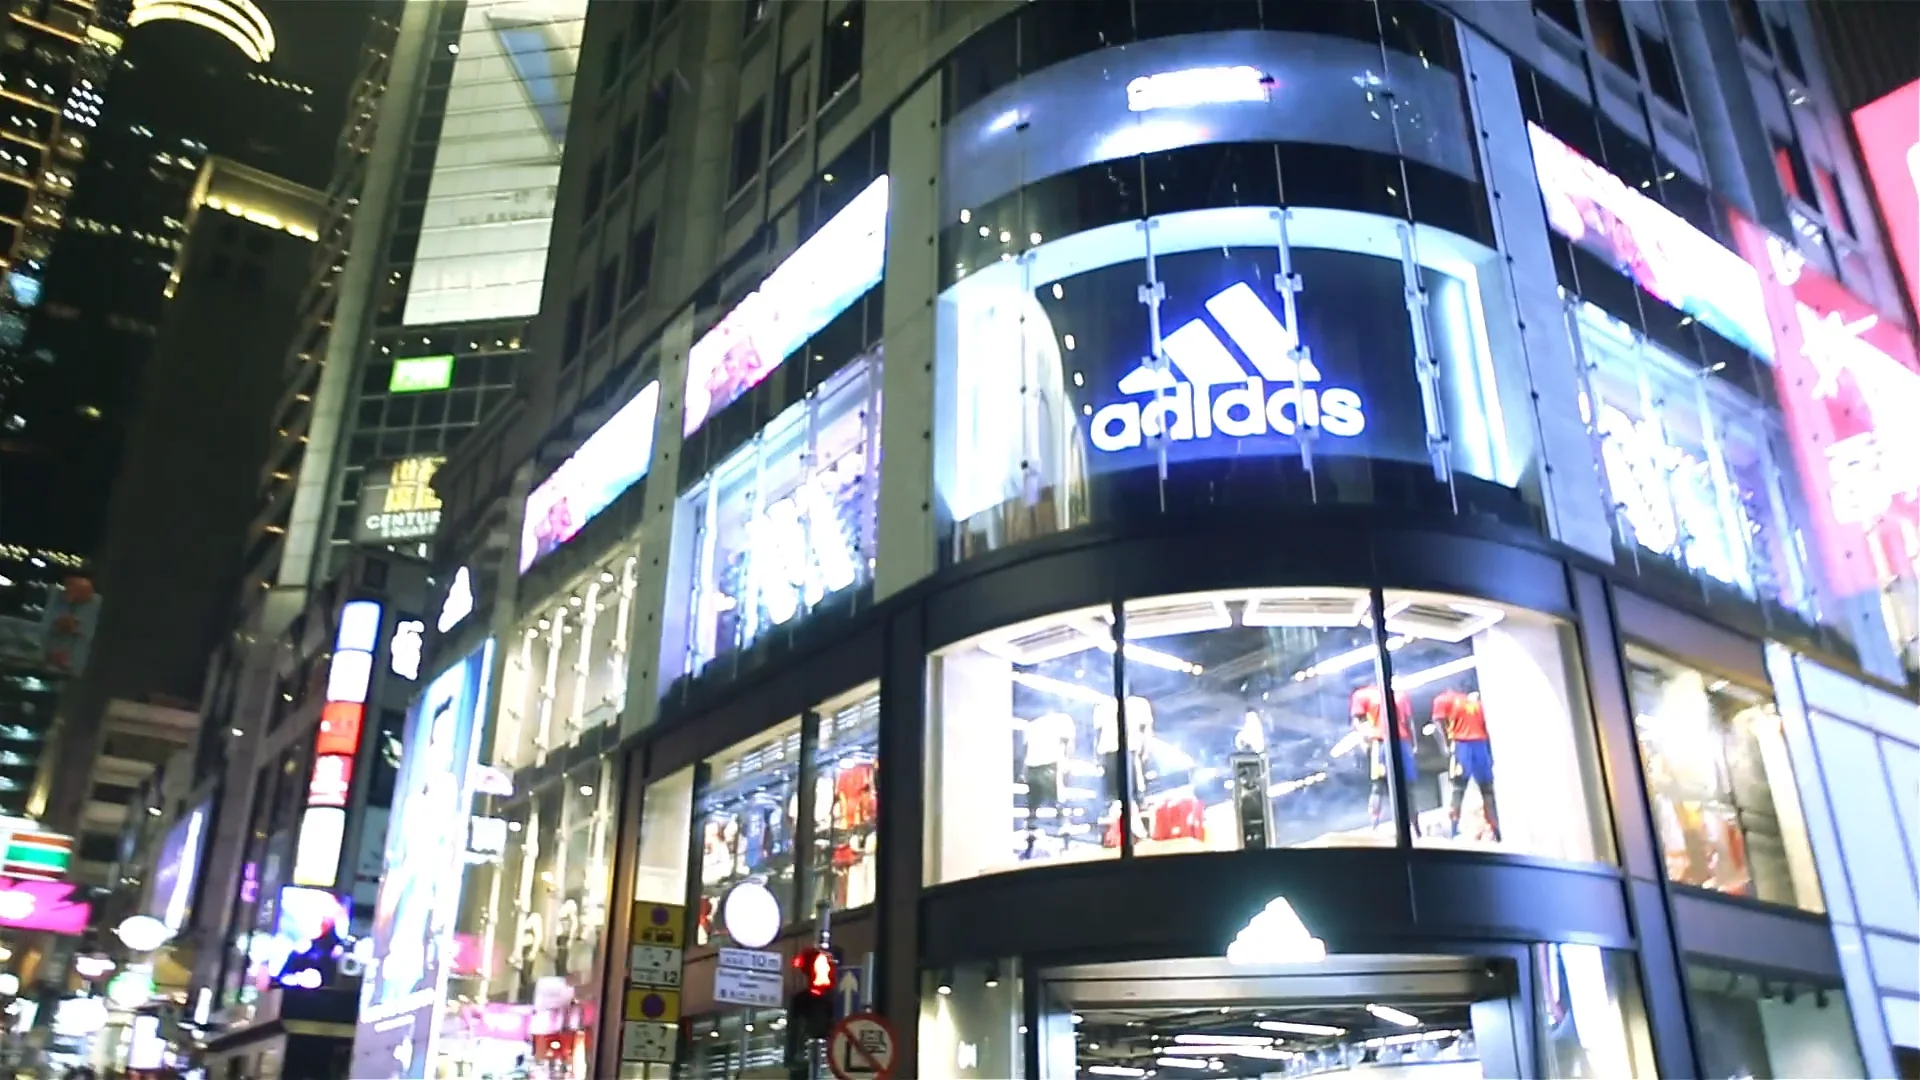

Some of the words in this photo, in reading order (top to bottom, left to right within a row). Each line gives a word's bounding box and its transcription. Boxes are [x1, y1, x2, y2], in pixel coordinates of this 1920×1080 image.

[1090, 376, 1365, 452] adidas
[365, 510, 441, 530] CENTUR
[664, 949, 673, 962] 7
[664, 970, 678, 984] 12
